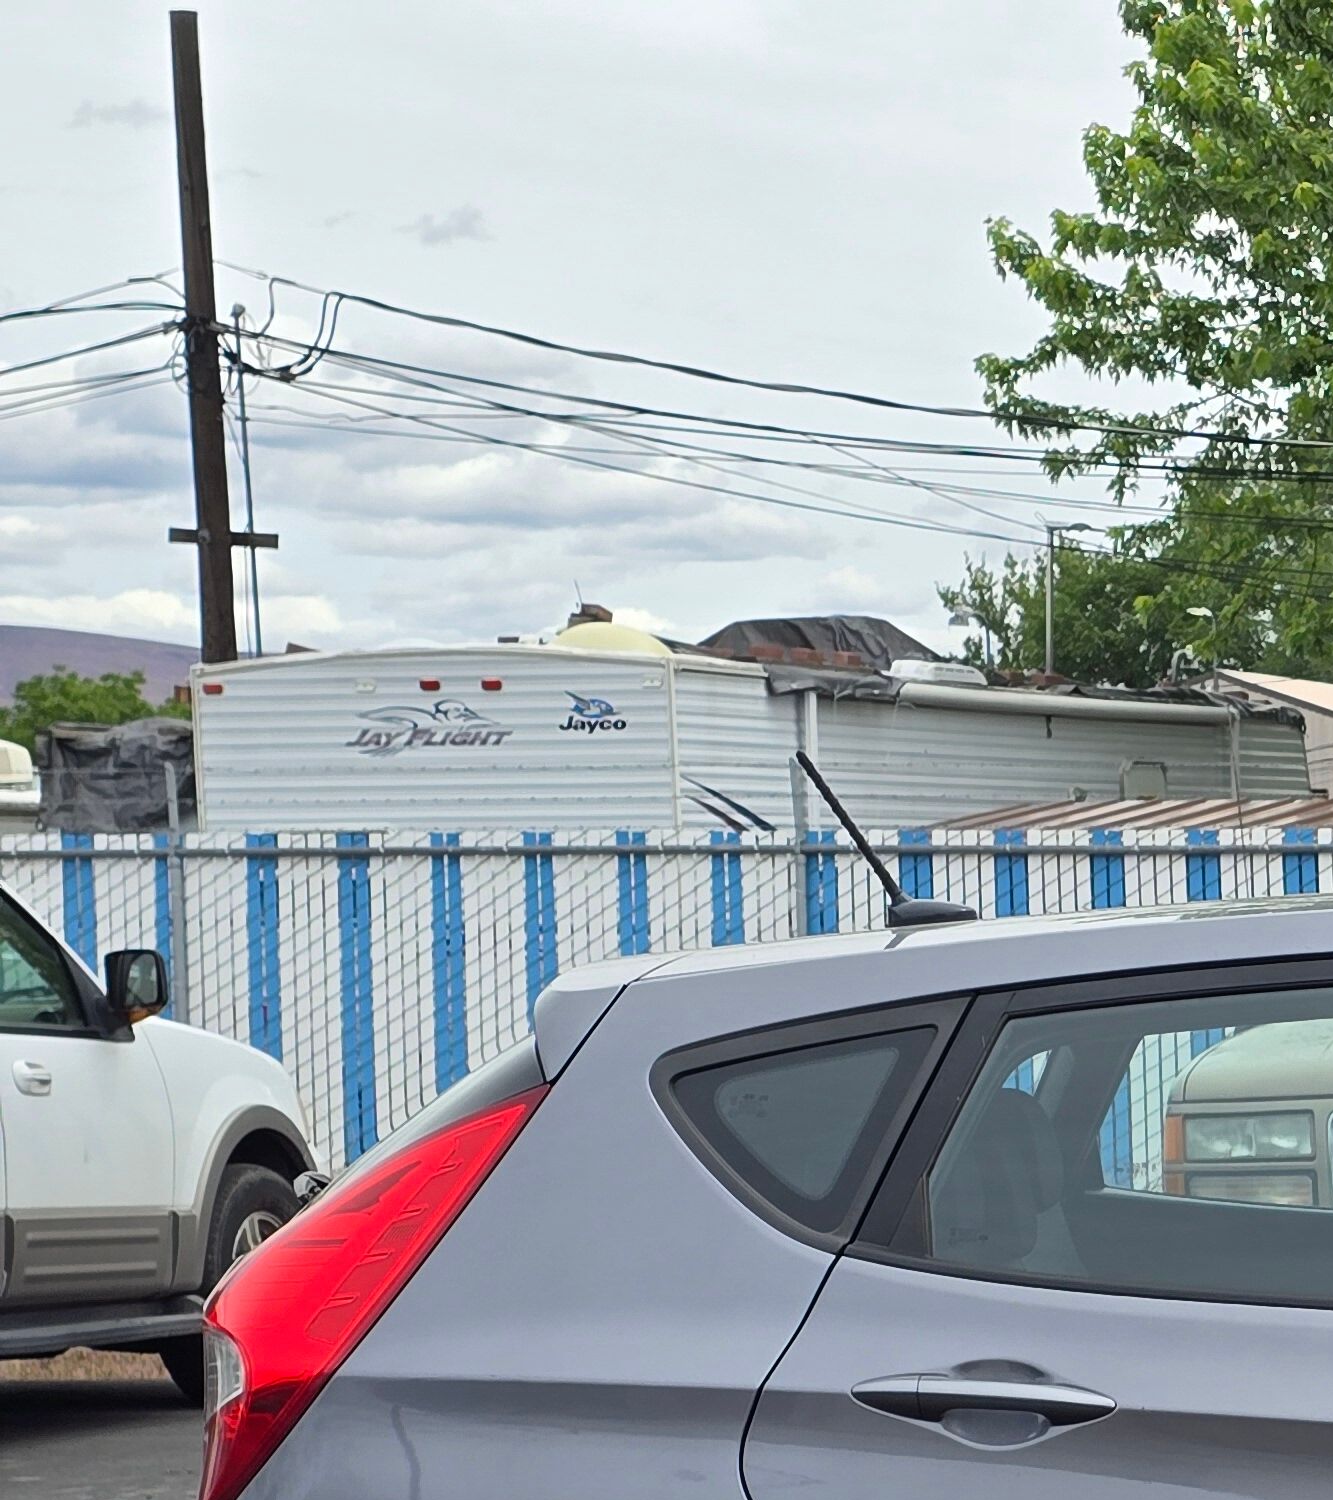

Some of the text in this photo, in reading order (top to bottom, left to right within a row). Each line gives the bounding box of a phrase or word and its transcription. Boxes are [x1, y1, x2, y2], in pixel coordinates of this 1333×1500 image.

[558, 715, 628, 734] Jayco
[345, 727, 514, 747] JAY FLIGHT
